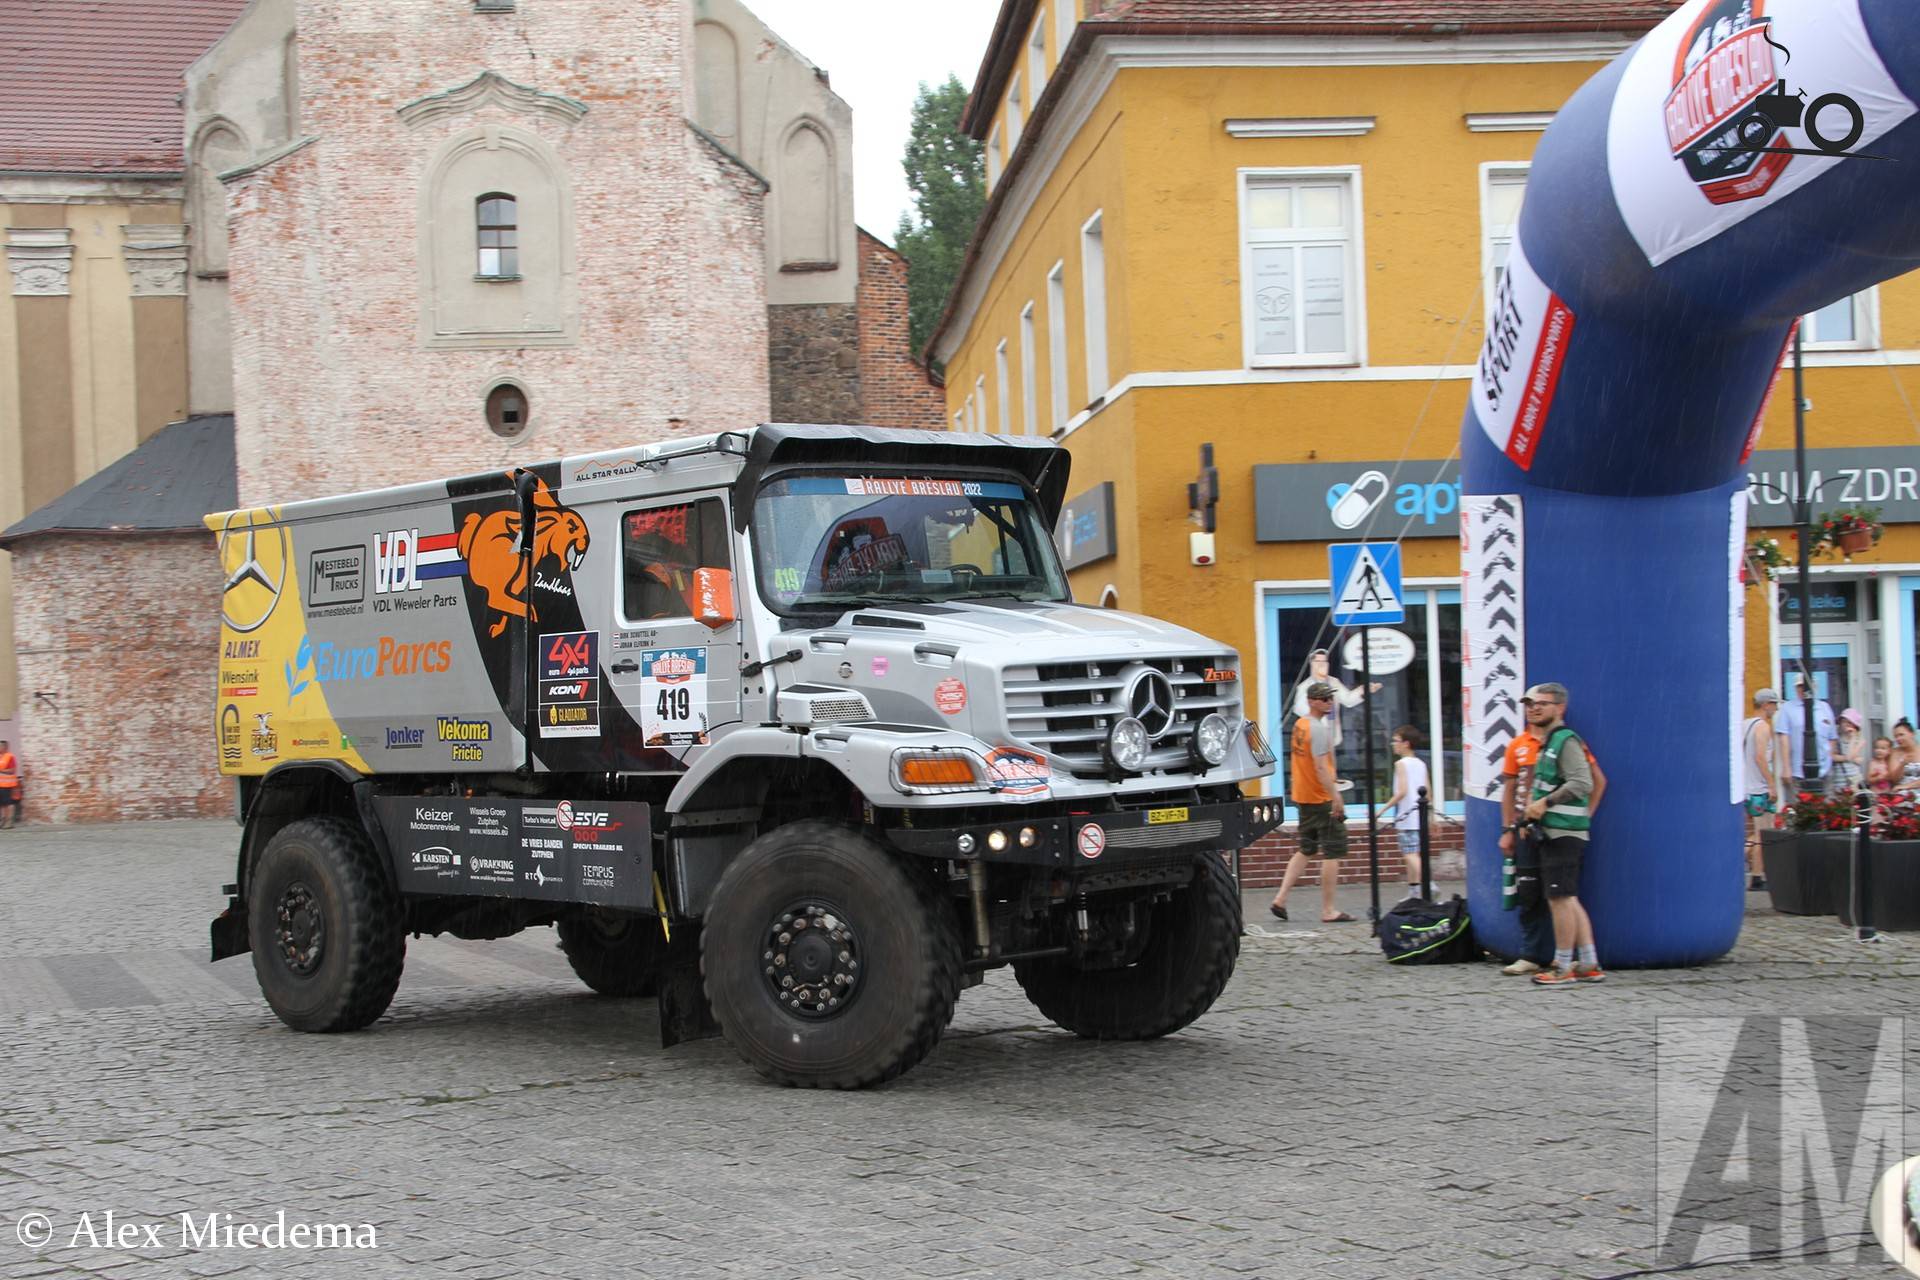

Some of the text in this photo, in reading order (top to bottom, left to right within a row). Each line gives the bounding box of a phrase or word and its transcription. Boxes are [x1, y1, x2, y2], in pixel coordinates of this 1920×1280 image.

[613, 466, 638, 475] RALLY
[865, 480, 983, 495] RALLYE BRESLAU 2022
[373, 528, 423, 594] VDL
[313, 557, 360, 586] MESTEBELD
[325, 571, 359, 591] TRUCKS
[373, 595, 457, 614] VDL Weweler Parts
[1787, 593, 1846, 609] ateka
[307, 604, 364, 619] www.mestebeld.nl
[224, 640, 261, 659] ALMEX
[314, 636, 451, 682] EuroParcs
[222, 669, 259, 684] Wensink
[548, 685, 582, 695] KONI
[656, 687, 690, 721] 419
[558, 707, 588, 721] GLADIATOR
[437, 718, 491, 741] Vekoma
[451, 745, 483, 761] Frictie
[415, 808, 453, 822] Keizer
[470, 807, 506, 818] Wissels Groep
[574, 812, 609, 827] ESVE
[410, 822, 461, 832] Motorenrevisie
[477, 817, 499, 826] Zutphen
[522, 838, 563, 849] DE VRIES BANDEN
[422, 853, 450, 864] KARSTEN
[531, 850, 554, 859] ZUTPHEN
[479, 858, 514, 871] VRAKKING
[582, 865, 614, 879] TEMPUS
[525, 871, 537, 881] RTC
